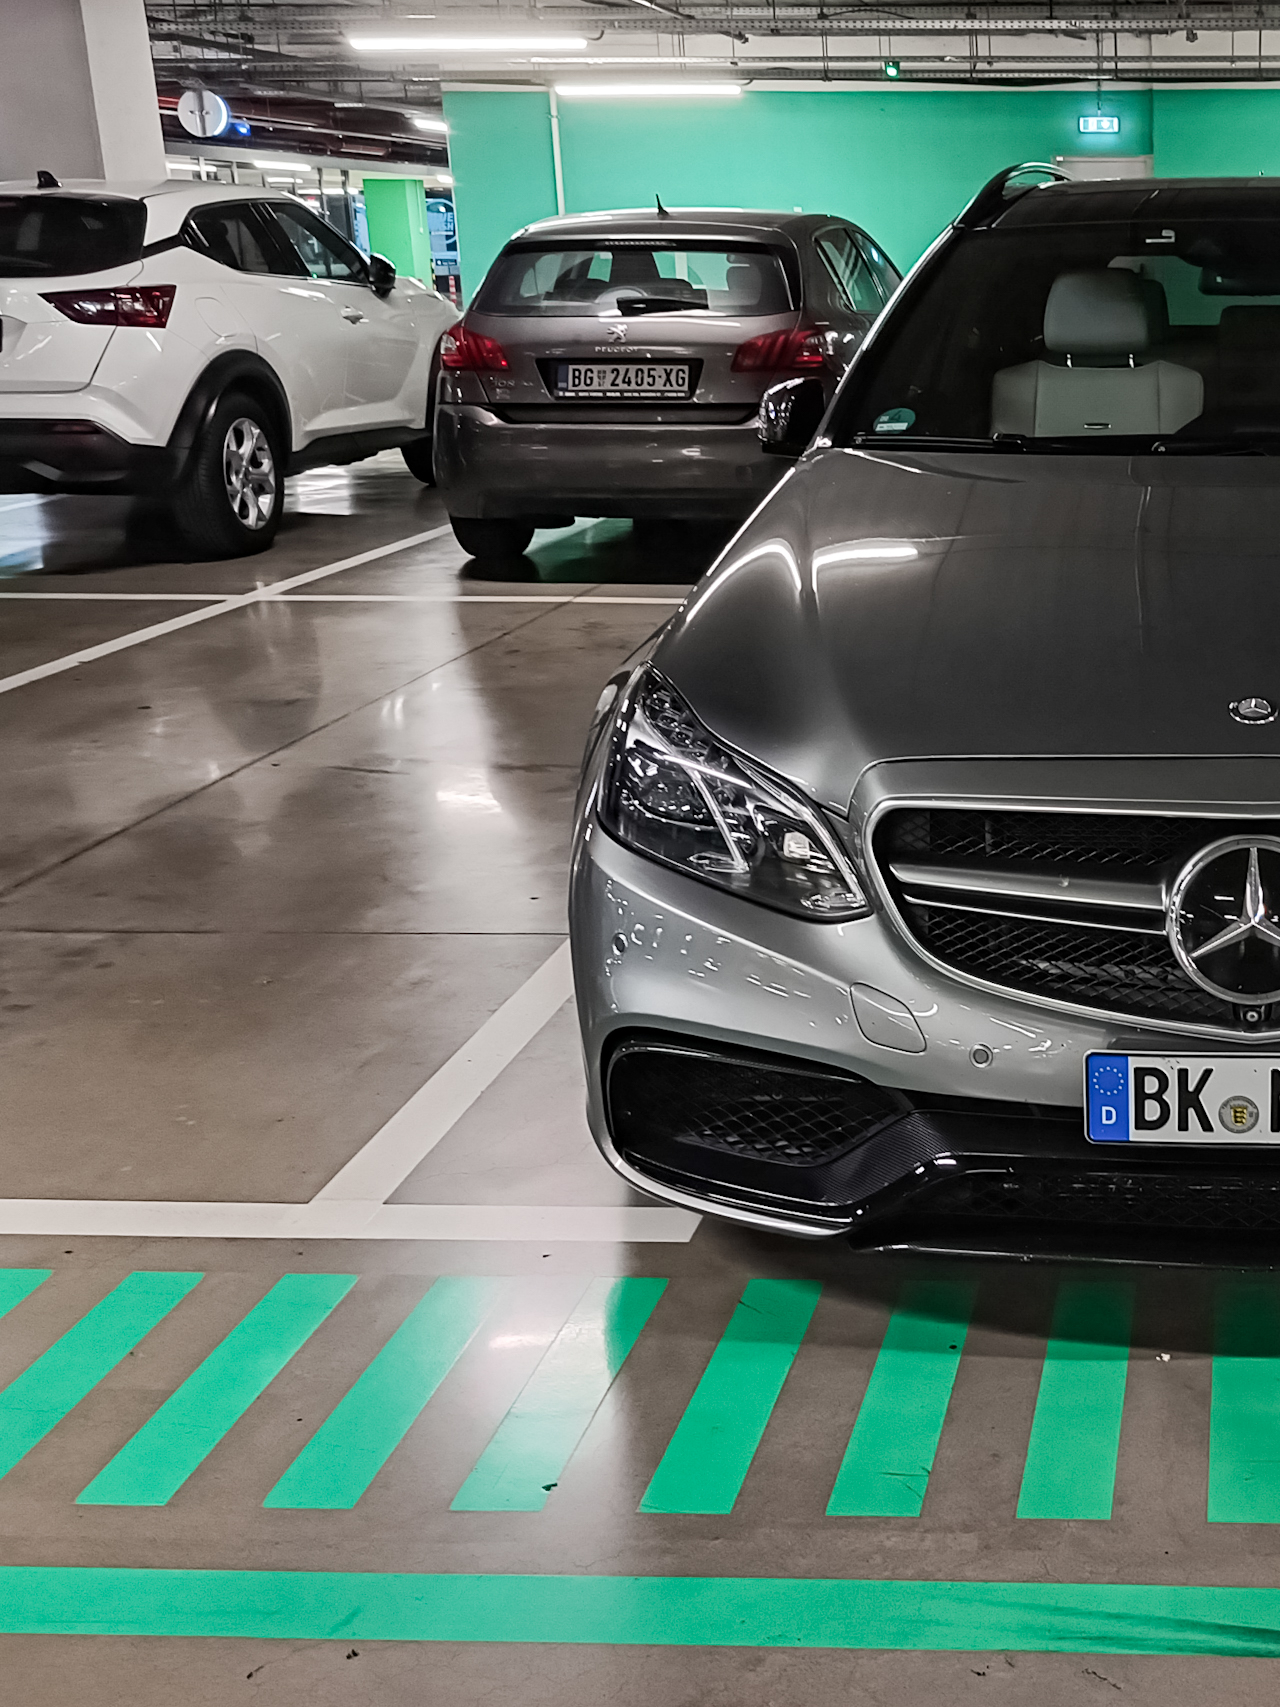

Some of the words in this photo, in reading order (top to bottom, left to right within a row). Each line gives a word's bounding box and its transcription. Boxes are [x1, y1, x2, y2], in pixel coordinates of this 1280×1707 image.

[572, 368, 594, 387] BG
[1101, 1106, 1117, 1125] D
[1134, 1067, 1214, 1132] BK
